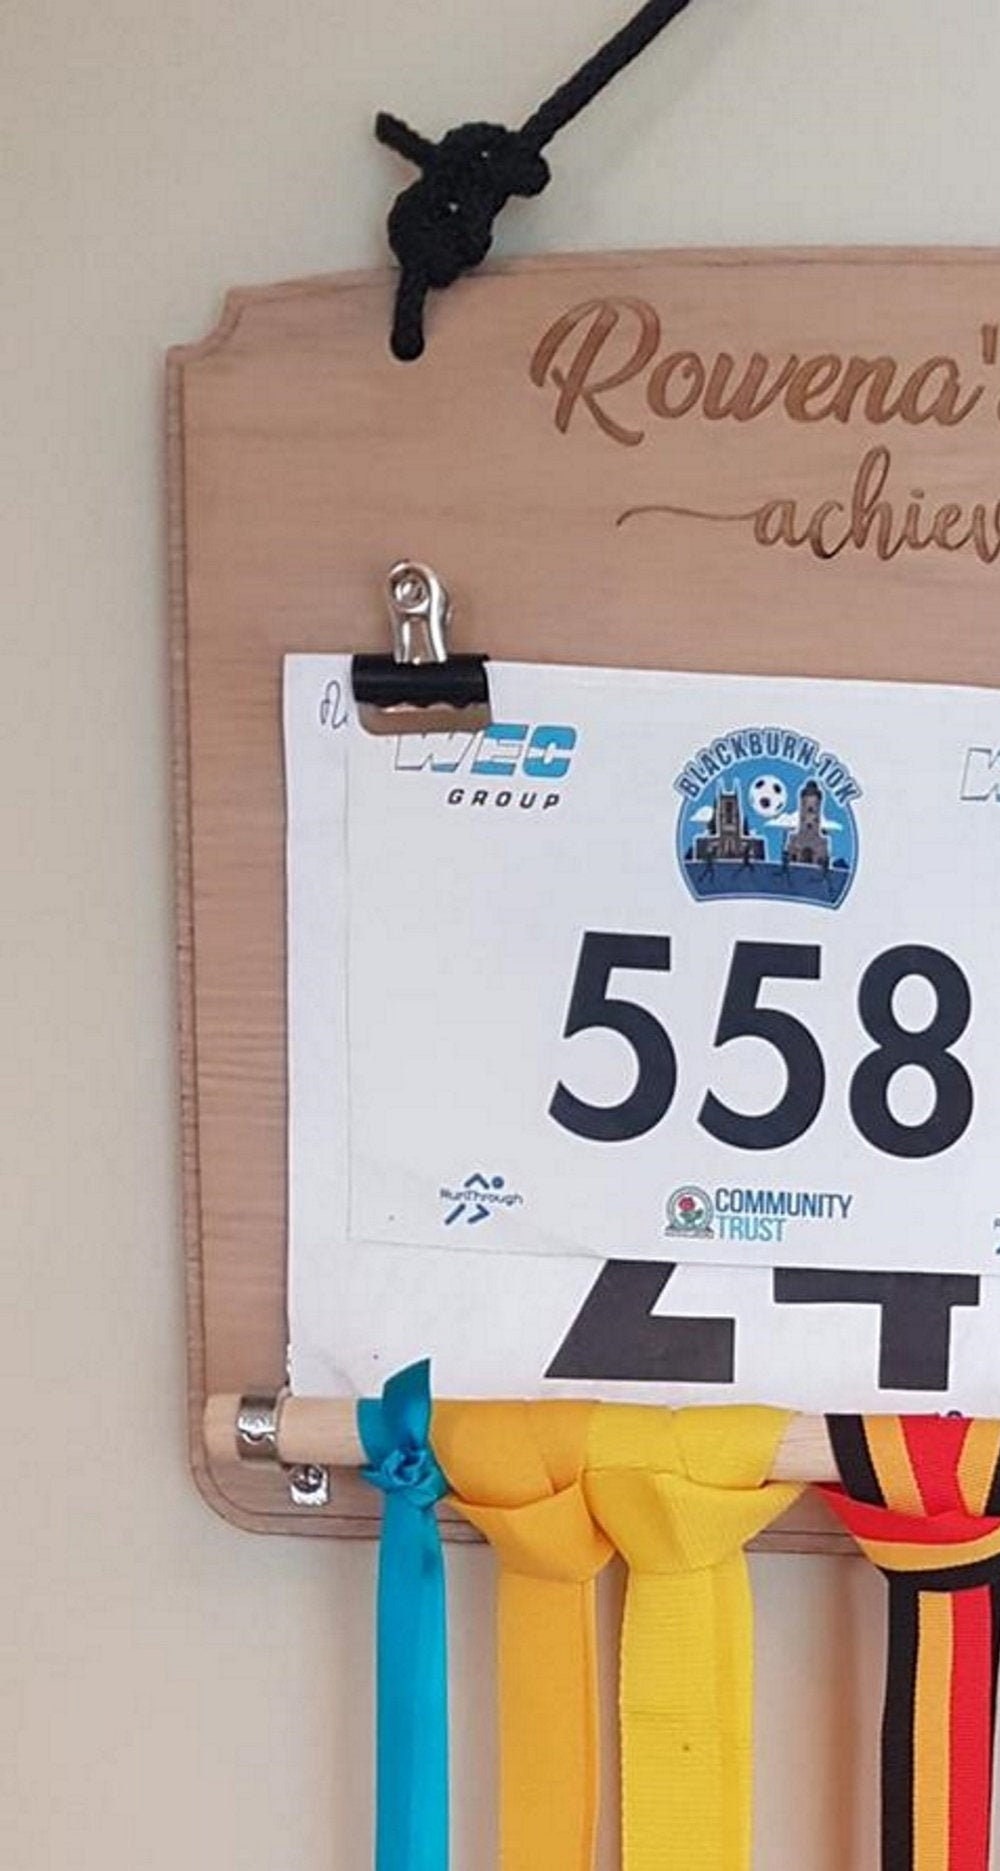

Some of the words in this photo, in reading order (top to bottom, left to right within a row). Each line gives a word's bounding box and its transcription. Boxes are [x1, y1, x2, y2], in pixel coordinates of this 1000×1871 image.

[394, 722, 578, 778] WEC
[677, 730, 817, 800] BLACKBURN
[817, 756, 860, 803] 10K
[447, 788, 561, 811] GROUP
[548, 930, 975, 1160] 558
[440, 1187, 524, 1207] RunThrough
[715, 1187, 853, 1219] COMMUNITY
[716, 1214, 788, 1242] TRUST
